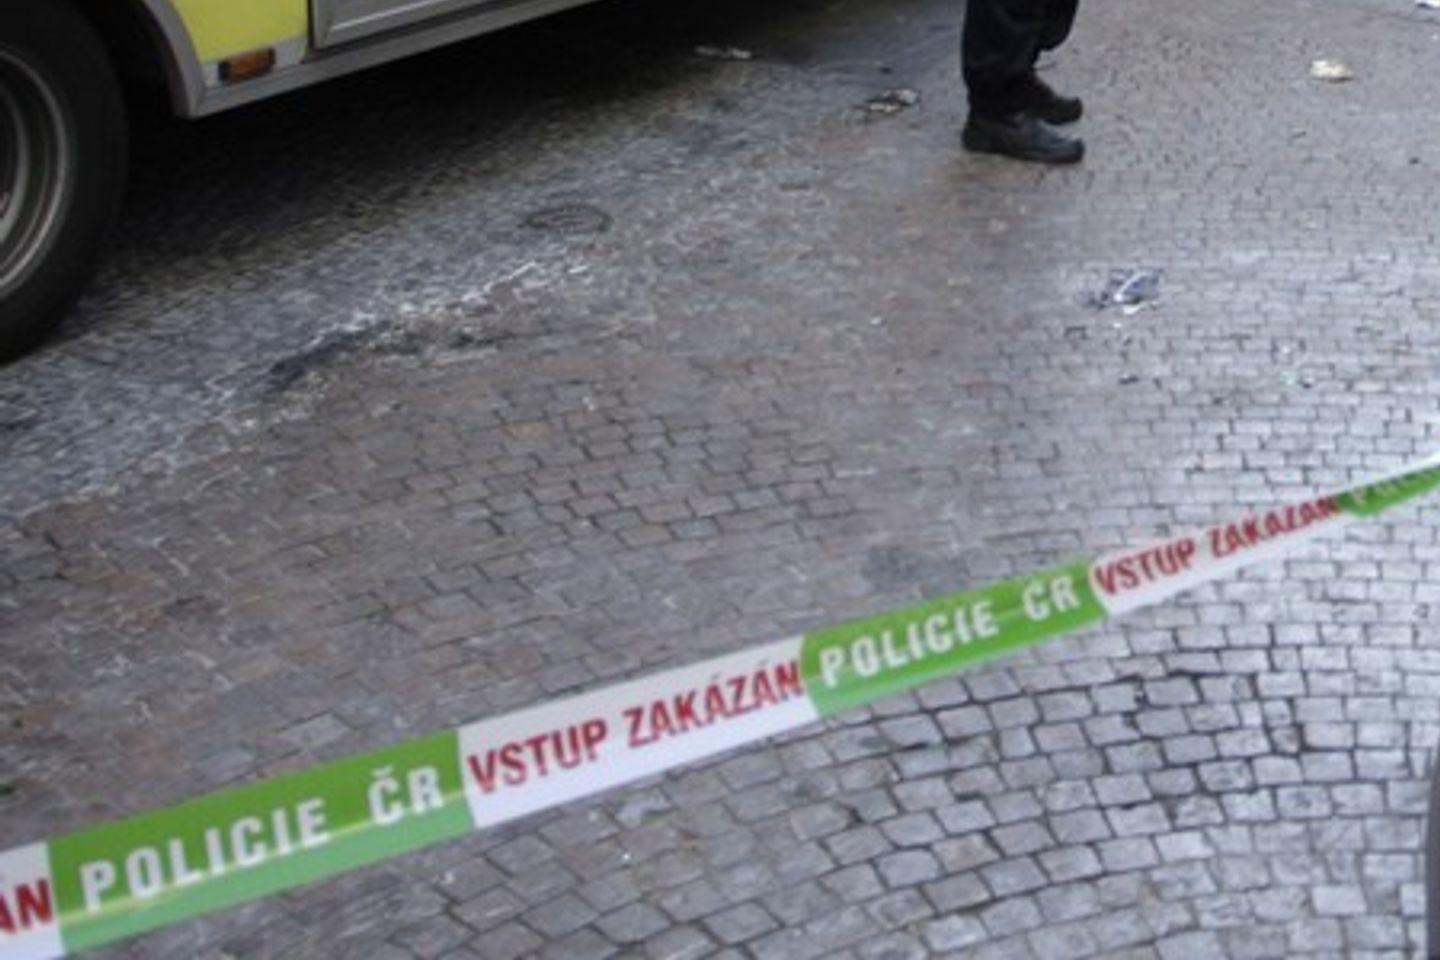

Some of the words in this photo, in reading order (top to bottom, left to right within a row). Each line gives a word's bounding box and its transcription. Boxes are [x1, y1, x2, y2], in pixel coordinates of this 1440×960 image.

[80, 796, 331, 914] POLICIE
[367, 765, 446, 826] ČR
[467, 718, 609, 794] VSTUP
[621, 658, 806, 749] ZAKÁZÁN
[818, 600, 999, 688] POLICIE
[1094, 538, 1197, 596] VSTUP
